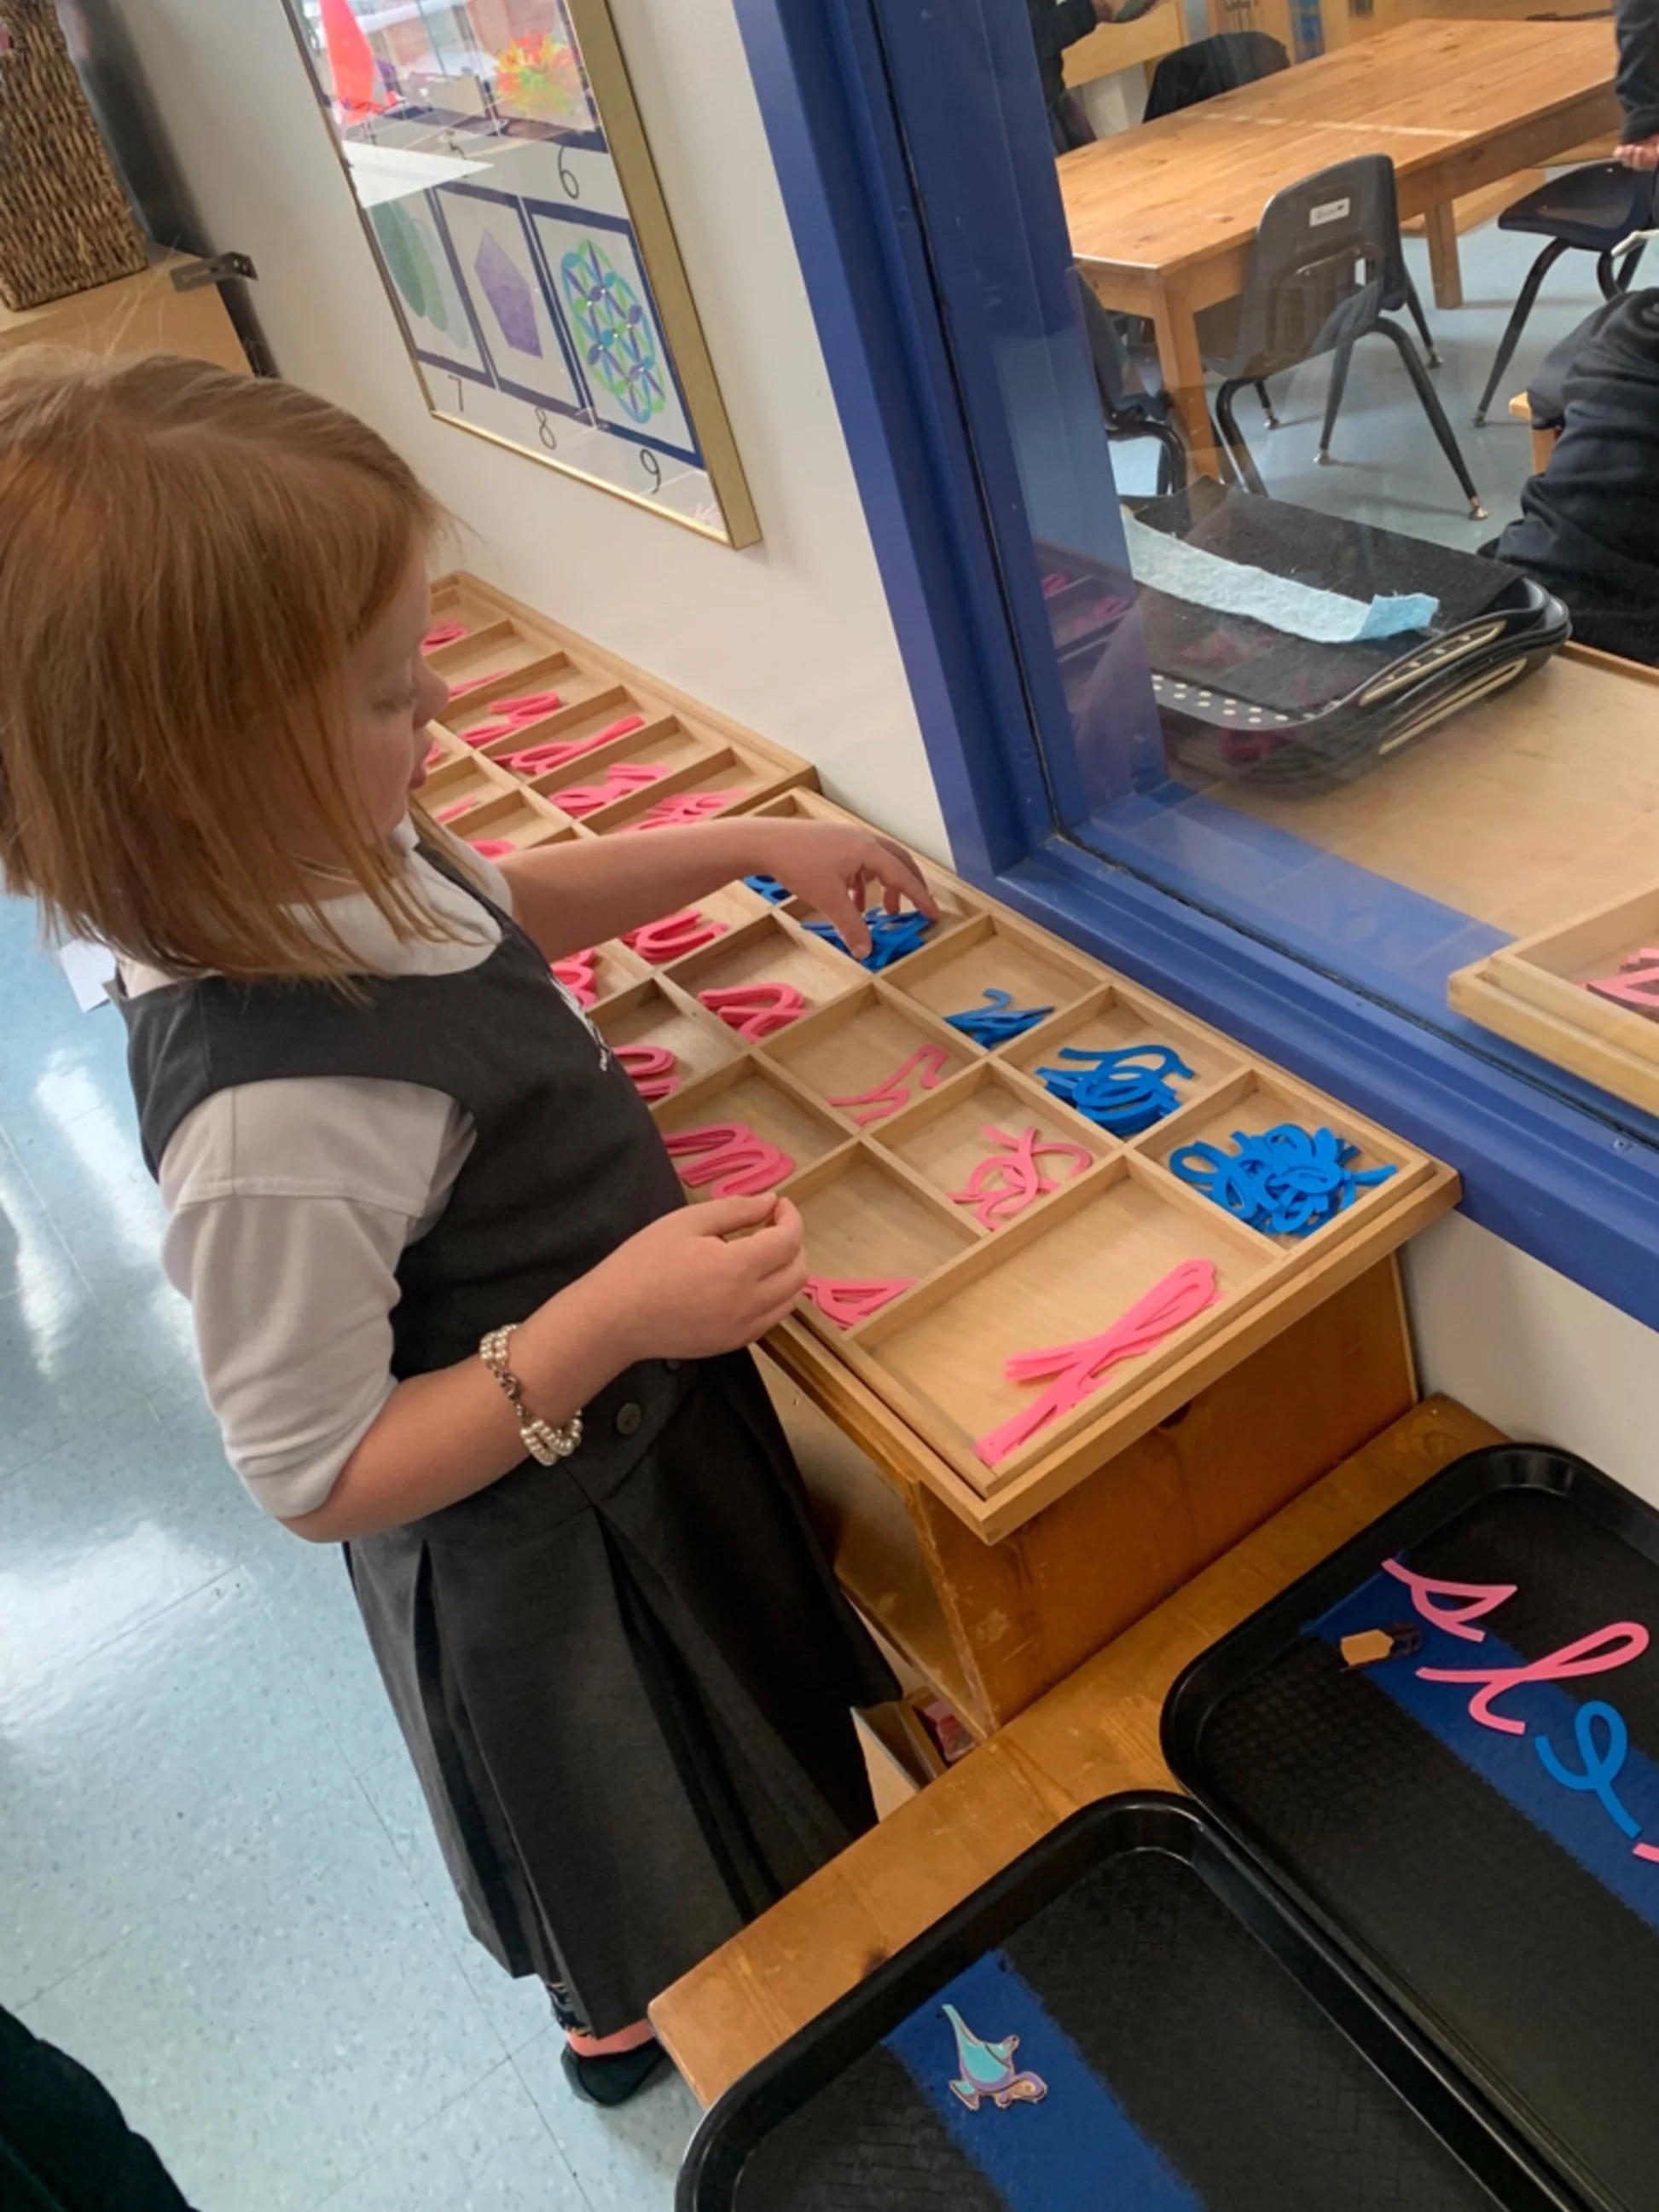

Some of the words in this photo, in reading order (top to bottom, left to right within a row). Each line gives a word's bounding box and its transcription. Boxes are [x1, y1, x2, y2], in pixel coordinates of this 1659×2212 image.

[558, 146, 579, 200] 6
[448, 374, 464, 412] 7
[535, 406, 557, 449] 8
[639, 448, 661, 494] 9
[1381, 1557, 1659, 1863] sle
